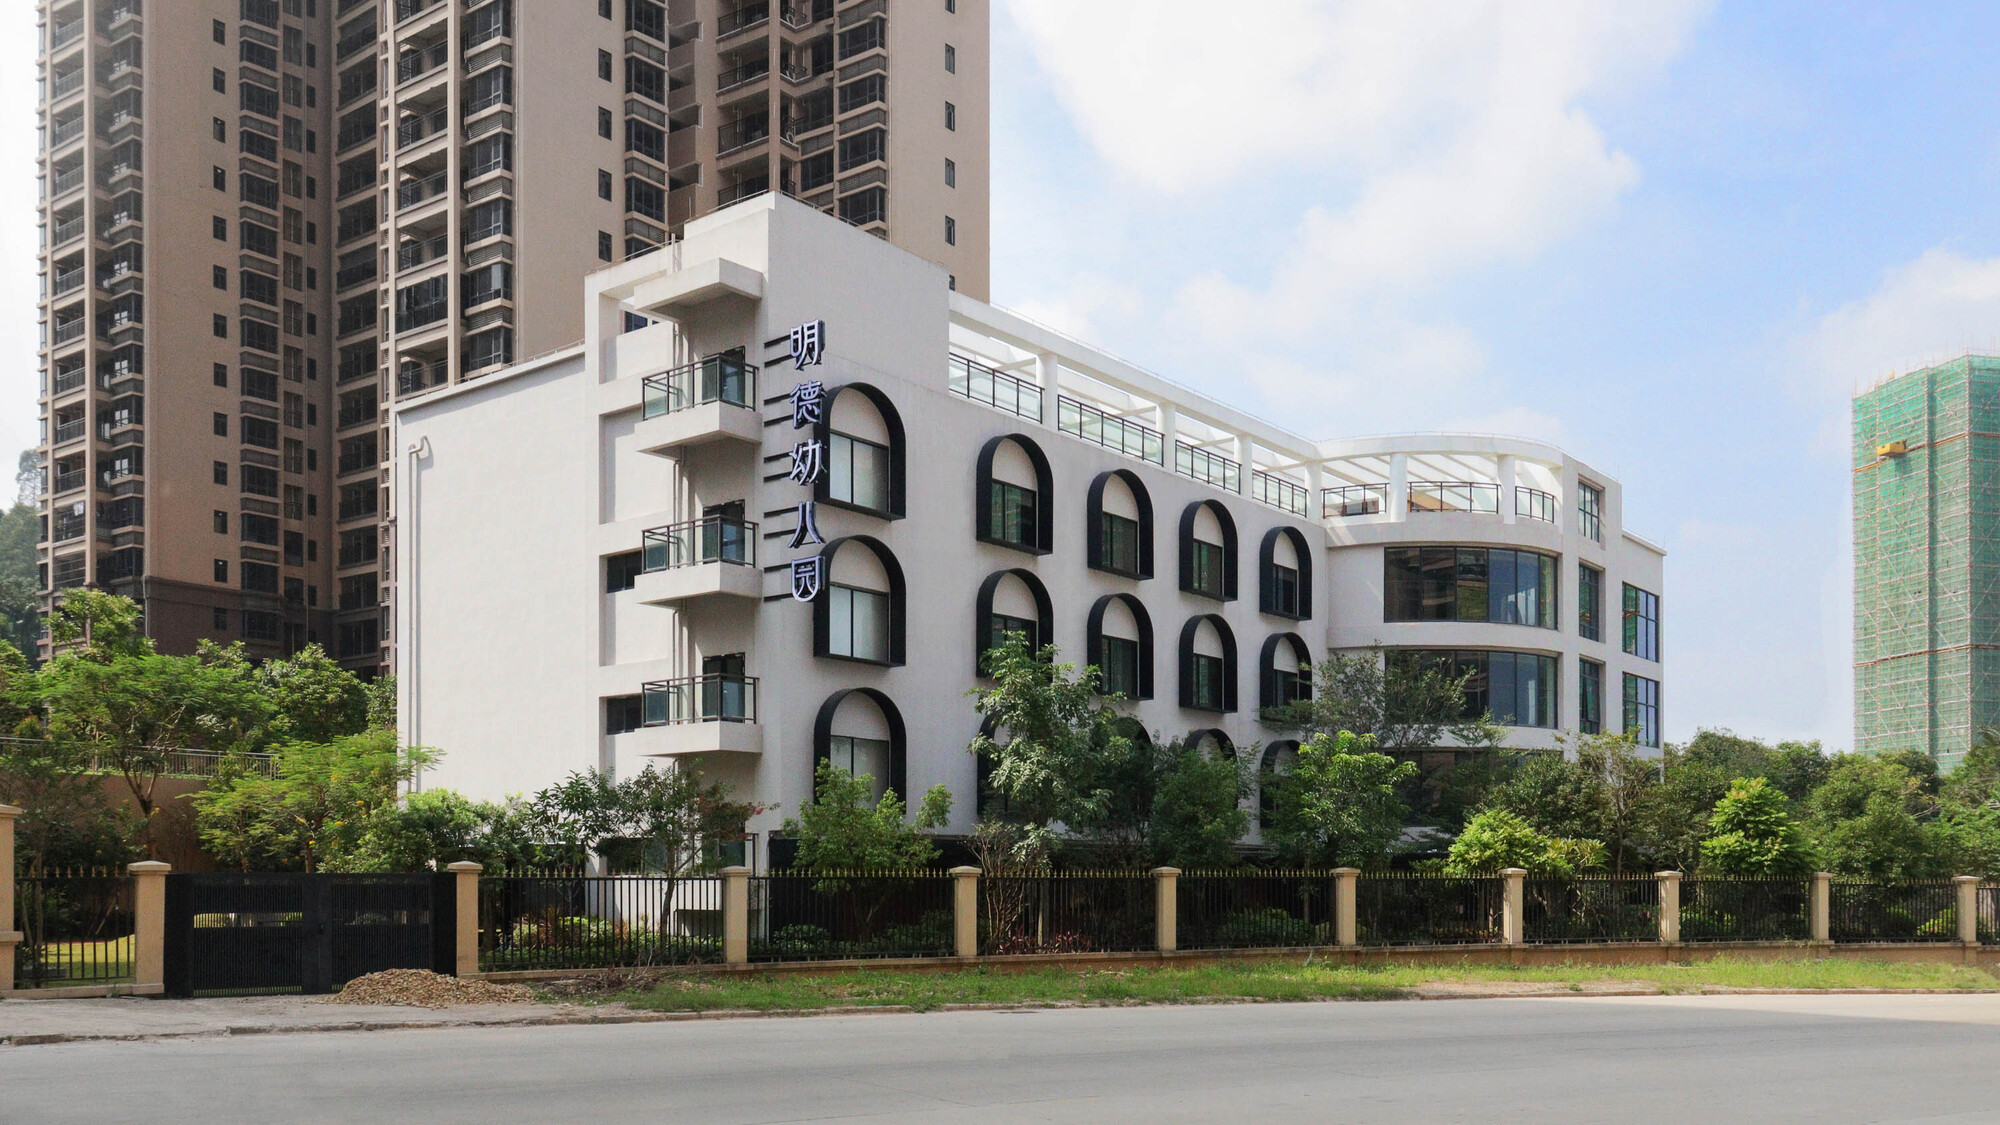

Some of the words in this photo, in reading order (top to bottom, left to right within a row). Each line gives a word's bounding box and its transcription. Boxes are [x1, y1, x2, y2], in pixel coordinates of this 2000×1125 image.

[788, 319, 825, 602] 明德幼儿园
